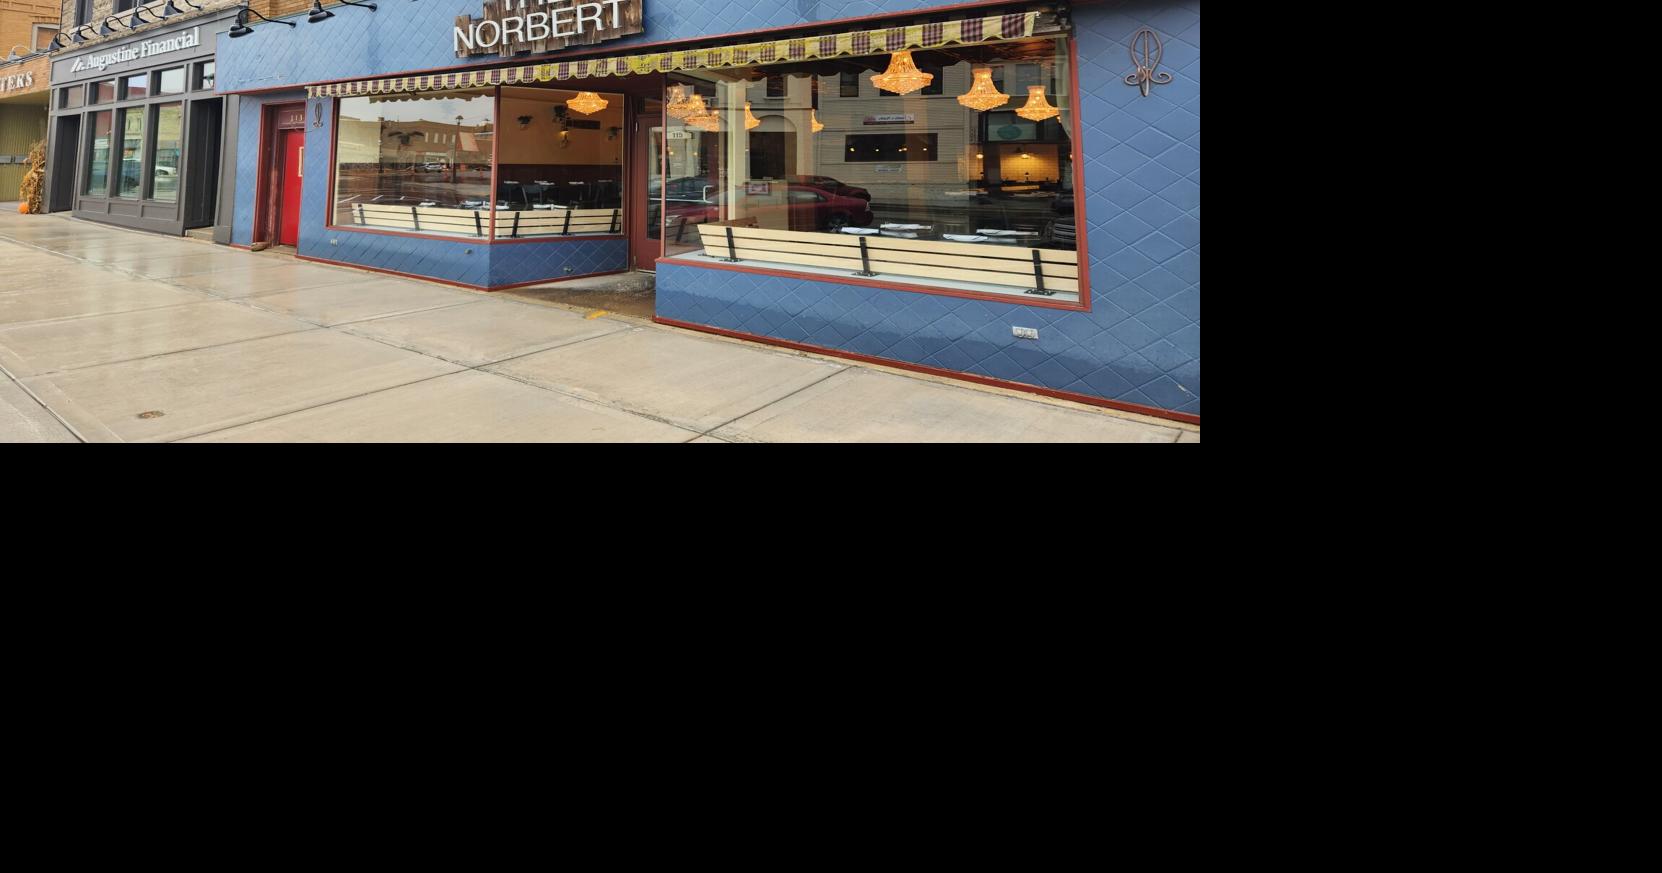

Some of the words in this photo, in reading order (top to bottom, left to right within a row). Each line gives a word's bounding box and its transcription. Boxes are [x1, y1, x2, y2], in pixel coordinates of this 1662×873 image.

[86, 46, 139, 71] Augustine
[140, 26, 200, 58] Financial
[453, 1, 624, 51] NORBERT
